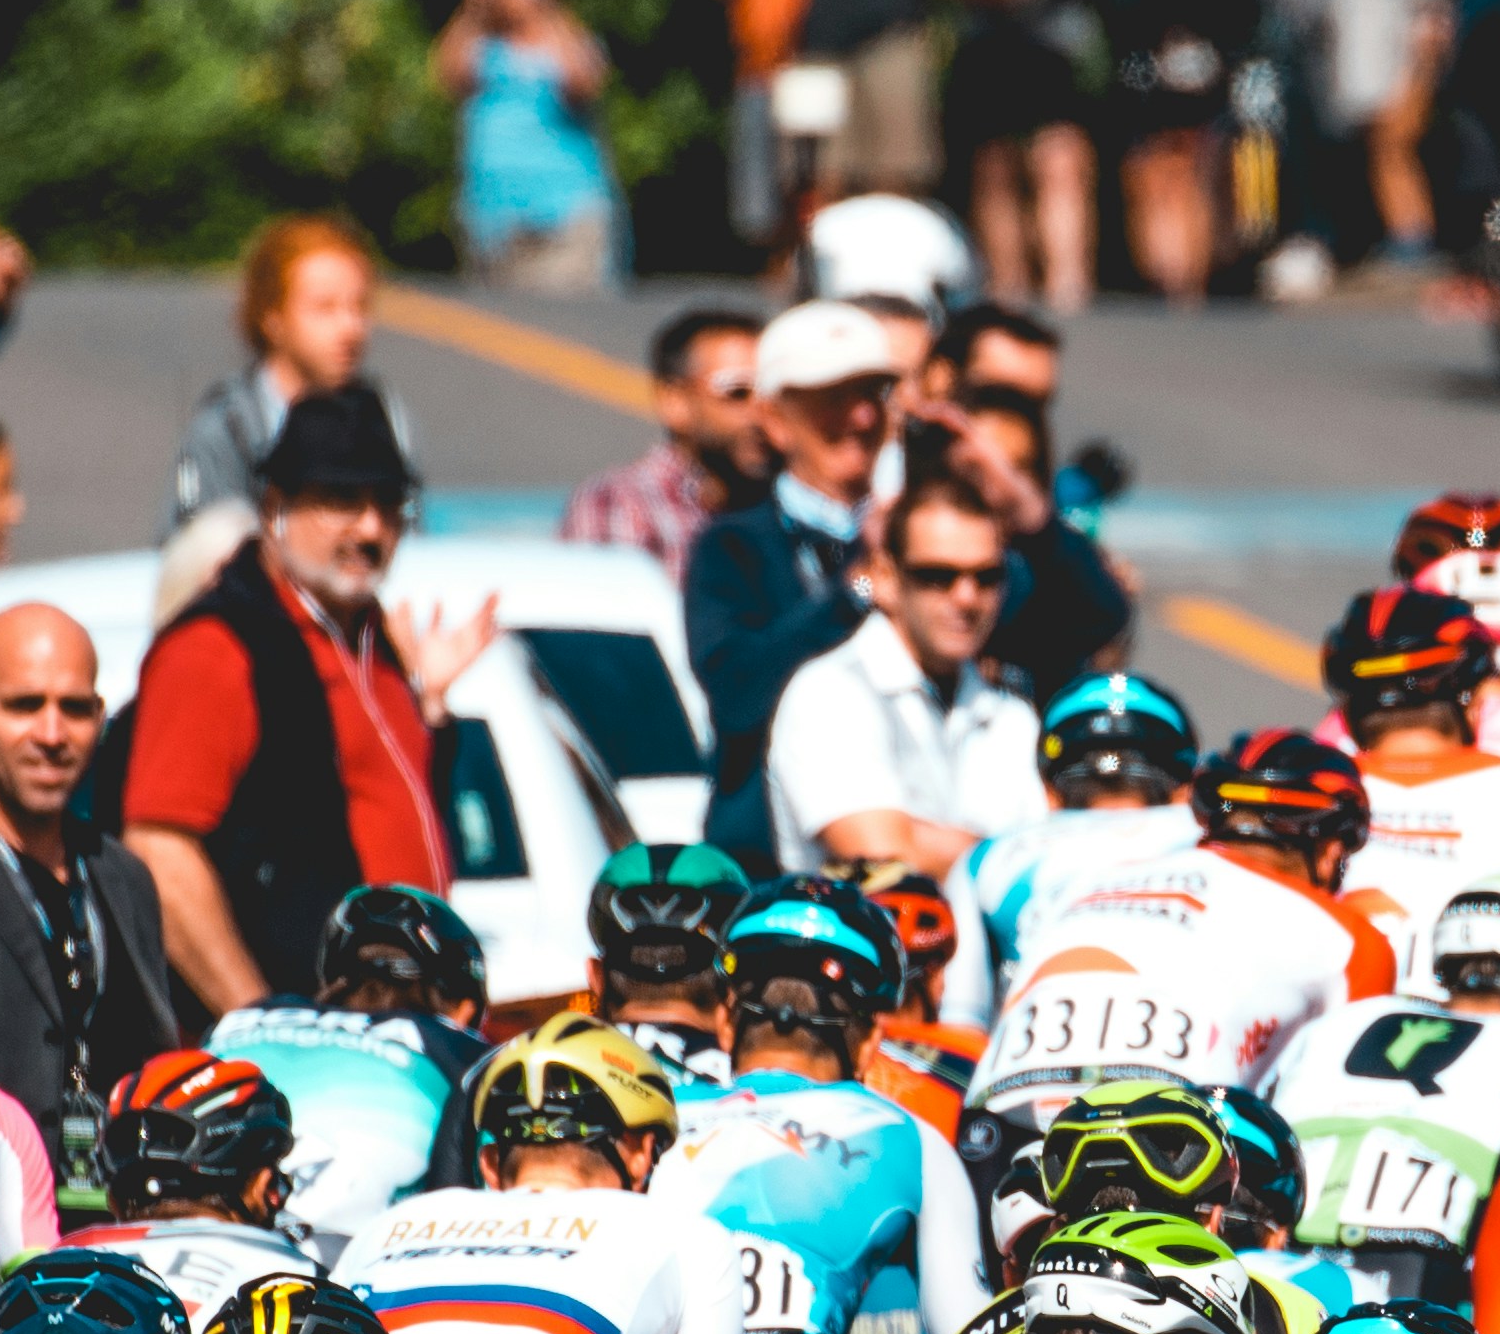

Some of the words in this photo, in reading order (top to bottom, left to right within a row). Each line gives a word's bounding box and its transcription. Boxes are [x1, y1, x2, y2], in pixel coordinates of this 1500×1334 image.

[1098, 997, 1194, 1061] 133
[1365, 1150, 1457, 1227] 171
[384, 1215, 599, 1247] BAHRAIN
